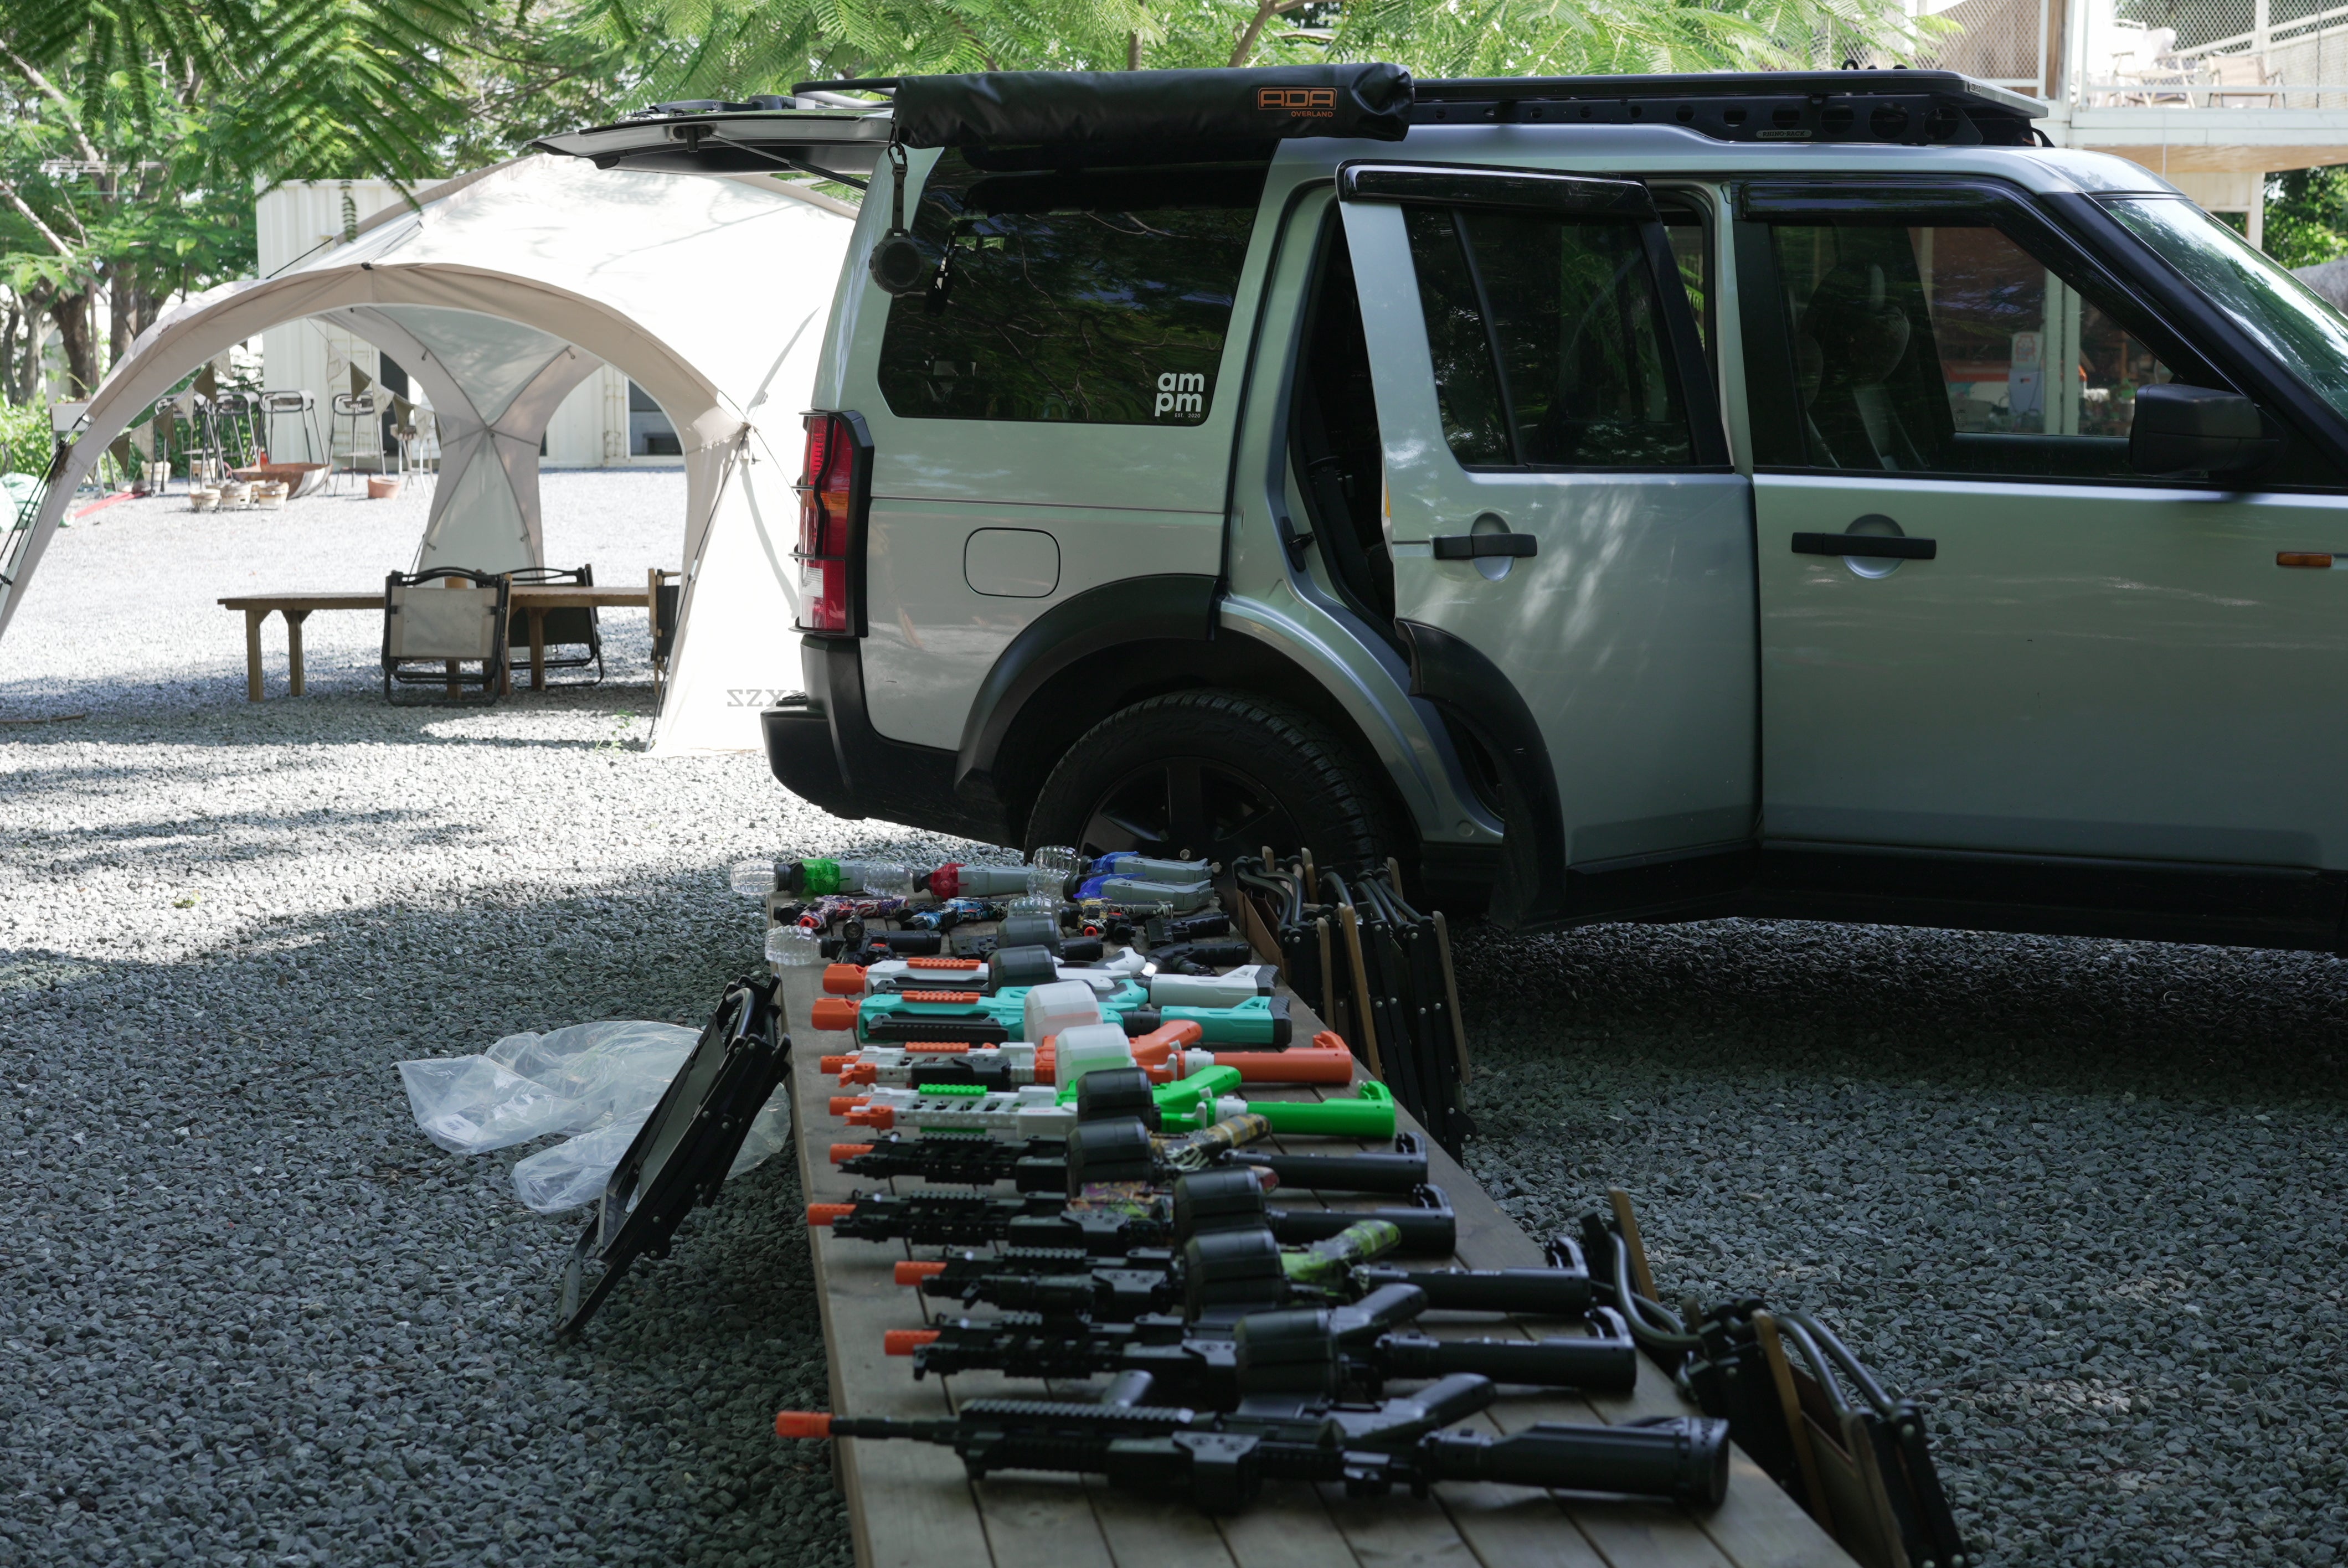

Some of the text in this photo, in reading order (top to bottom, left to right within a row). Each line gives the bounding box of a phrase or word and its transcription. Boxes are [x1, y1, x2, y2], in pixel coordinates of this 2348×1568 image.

[1260, 90, 1334, 107] ADA
[1157, 372, 1205, 392] am
[1154, 393, 1202, 417] pm
